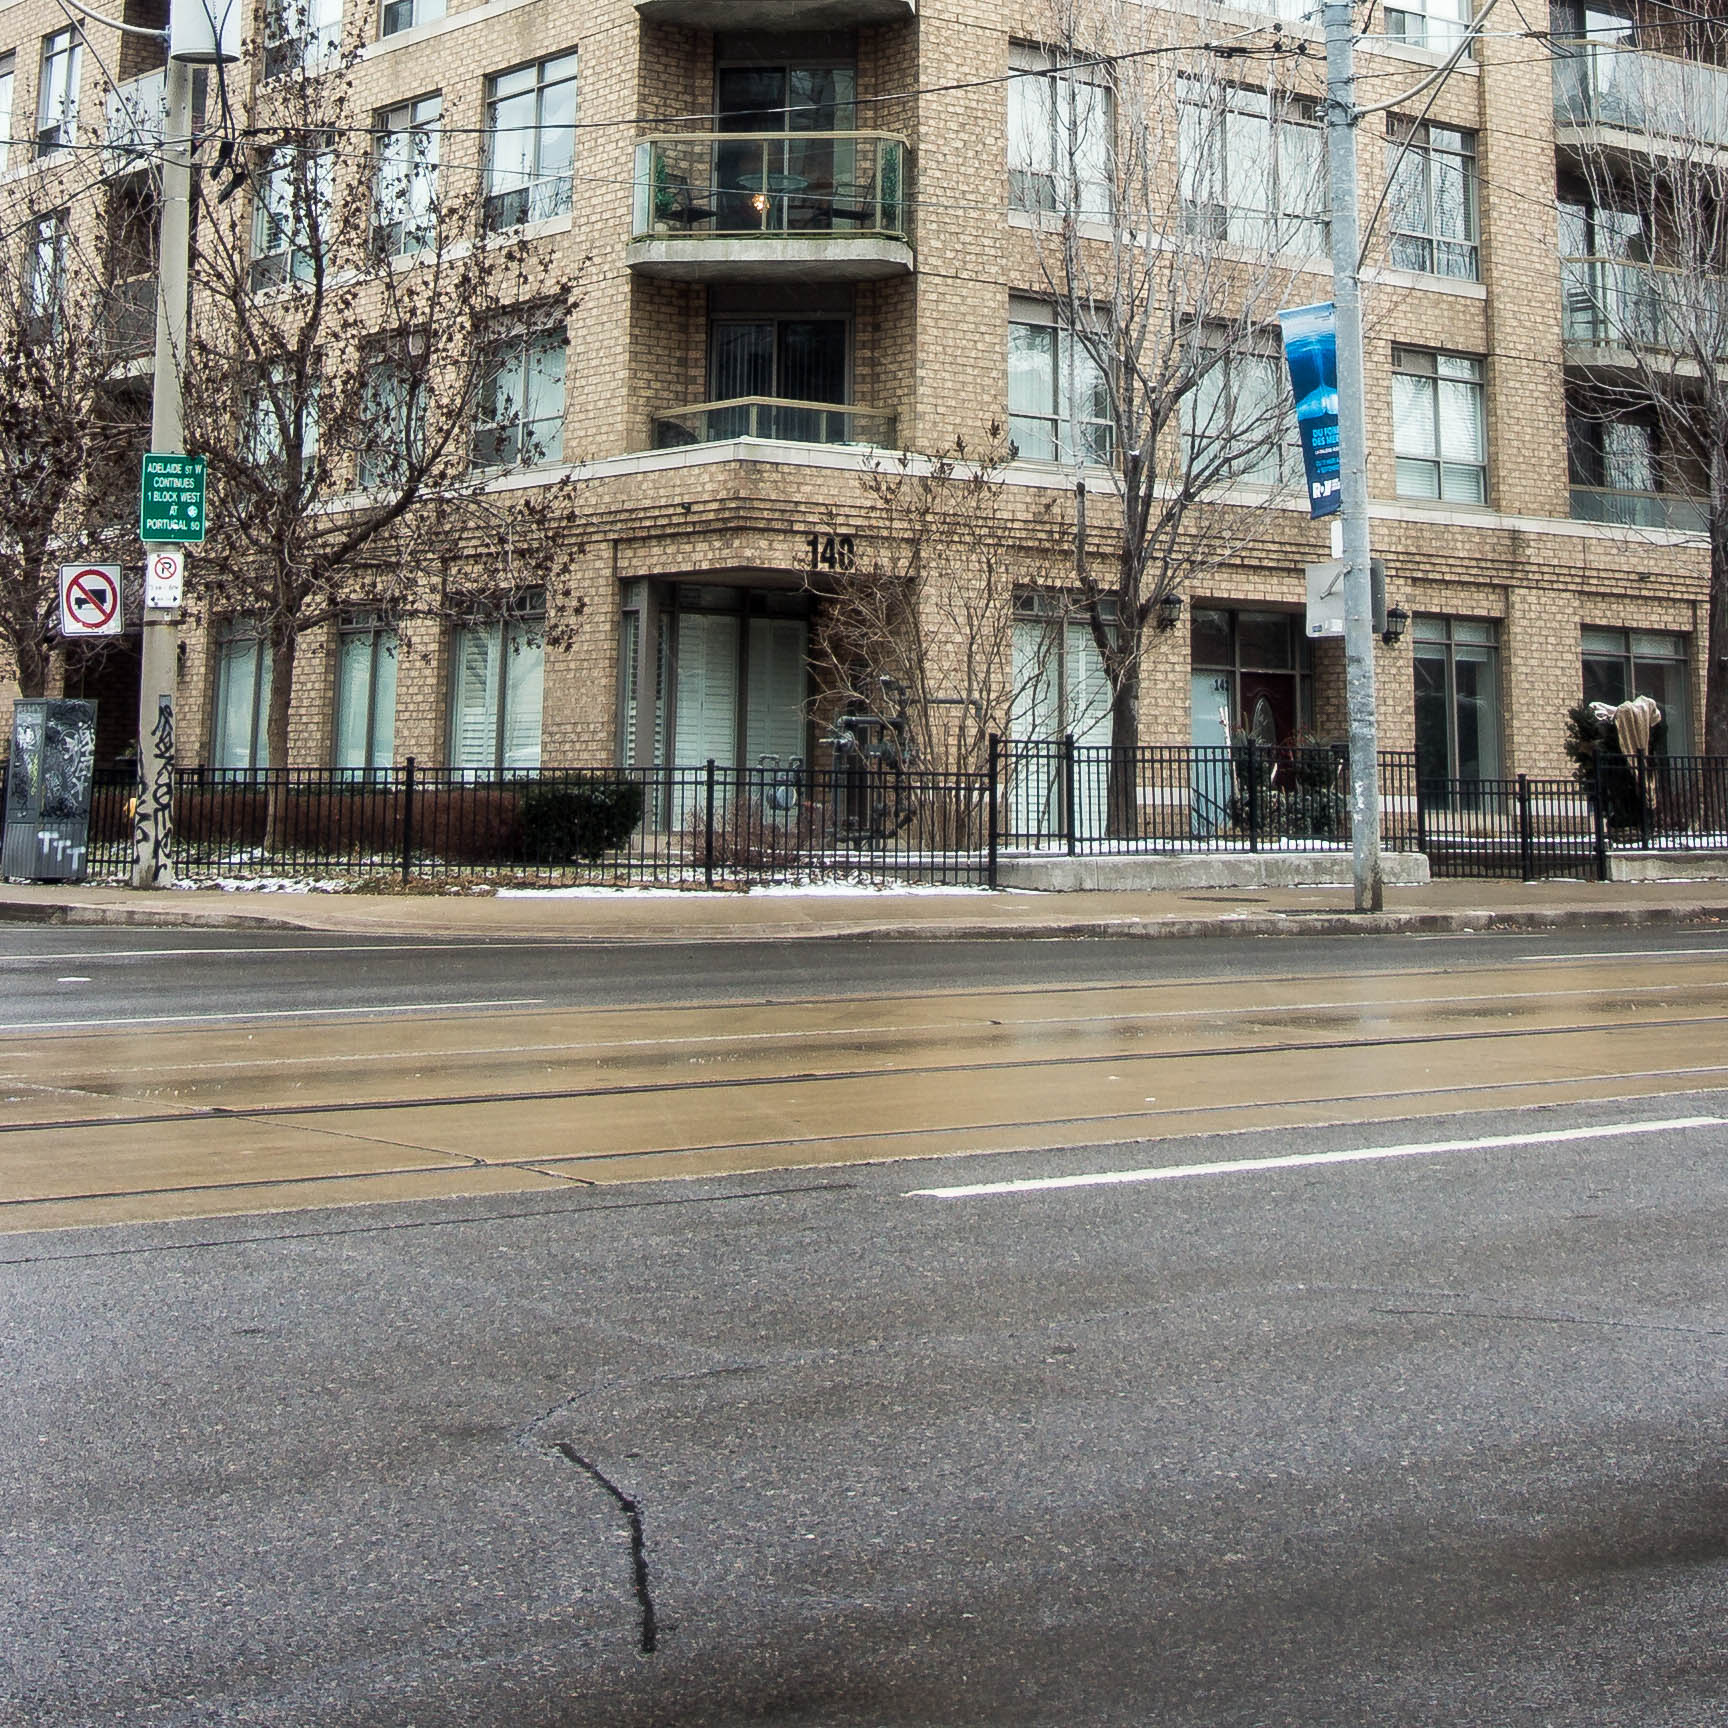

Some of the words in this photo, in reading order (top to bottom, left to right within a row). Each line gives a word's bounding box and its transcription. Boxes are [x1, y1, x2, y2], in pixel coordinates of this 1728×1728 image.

[147, 462, 183, 474] ADELAIDE
[194, 464, 203, 475] W
[153, 476, 195, 489] CONTINUES
[153, 490, 178, 502] BLOCK
[180, 492, 201, 503] WEST
[169, 504, 179, 516] AT
[147, 518, 188, 531] PORTUGAL
[806, 534, 855, 571] 140
